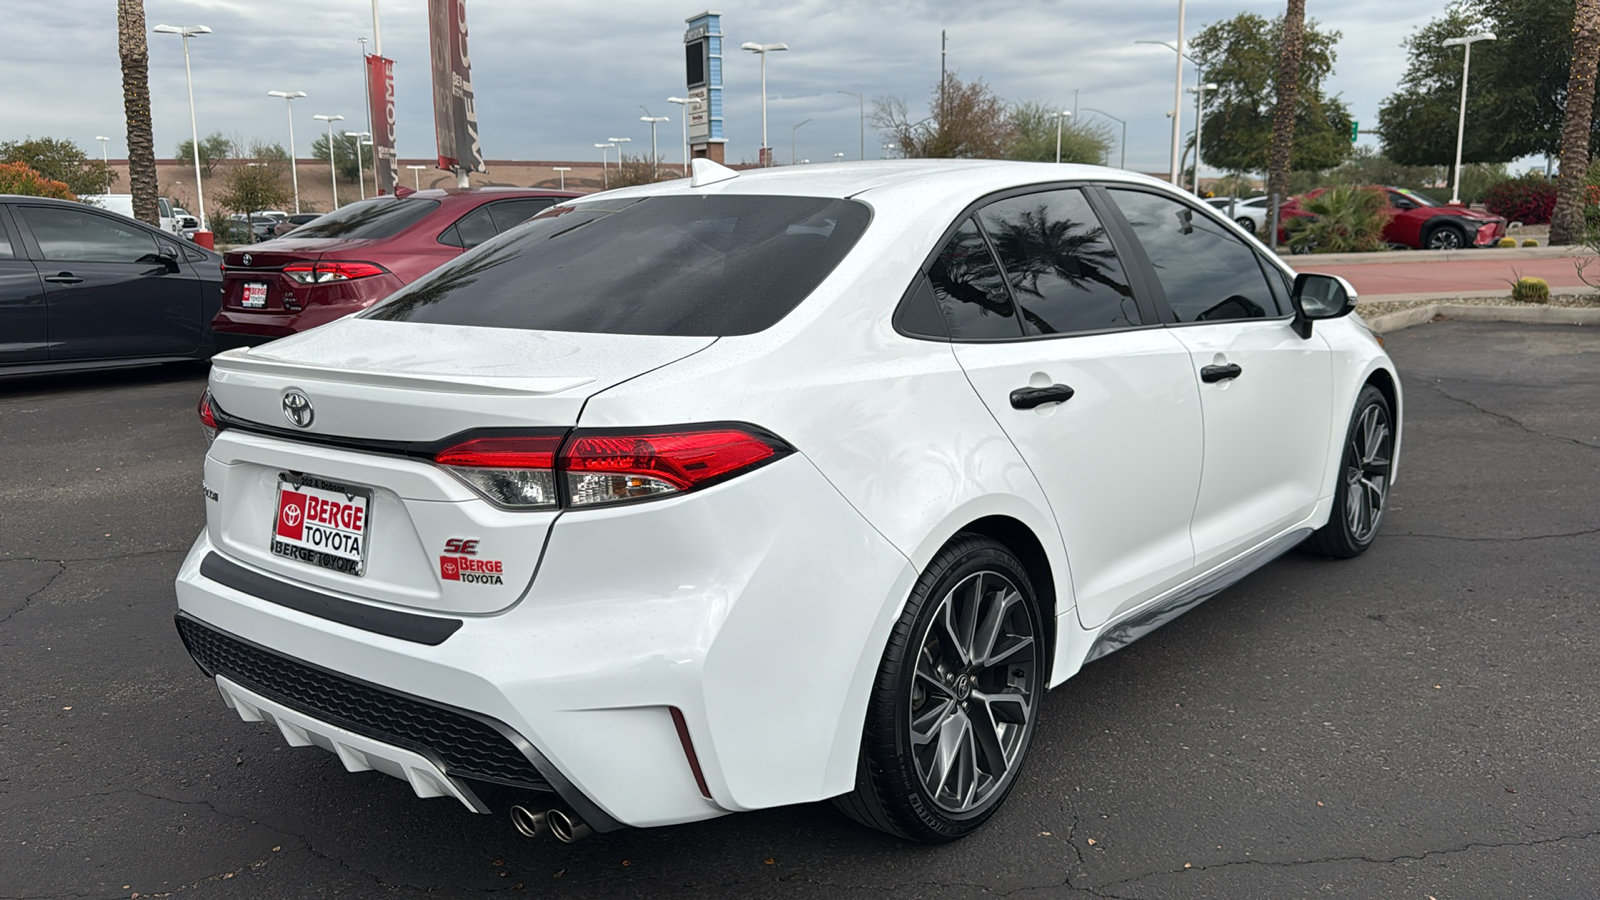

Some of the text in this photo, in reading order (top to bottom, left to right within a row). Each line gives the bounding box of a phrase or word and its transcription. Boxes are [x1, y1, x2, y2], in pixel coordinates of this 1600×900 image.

[301, 477, 313, 487] 202
[321, 481, 346, 493] Dobson
[306, 495, 363, 532] BERGE
[305, 525, 360, 556] TOYOTA
[443, 538, 480, 555] SE
[274, 540, 359, 575] BERGE TOYOTA
[459, 556, 503, 573] BERGE
[460, 573, 504, 585] TOYOTA
[909, 794, 949, 834] MICHELIN
